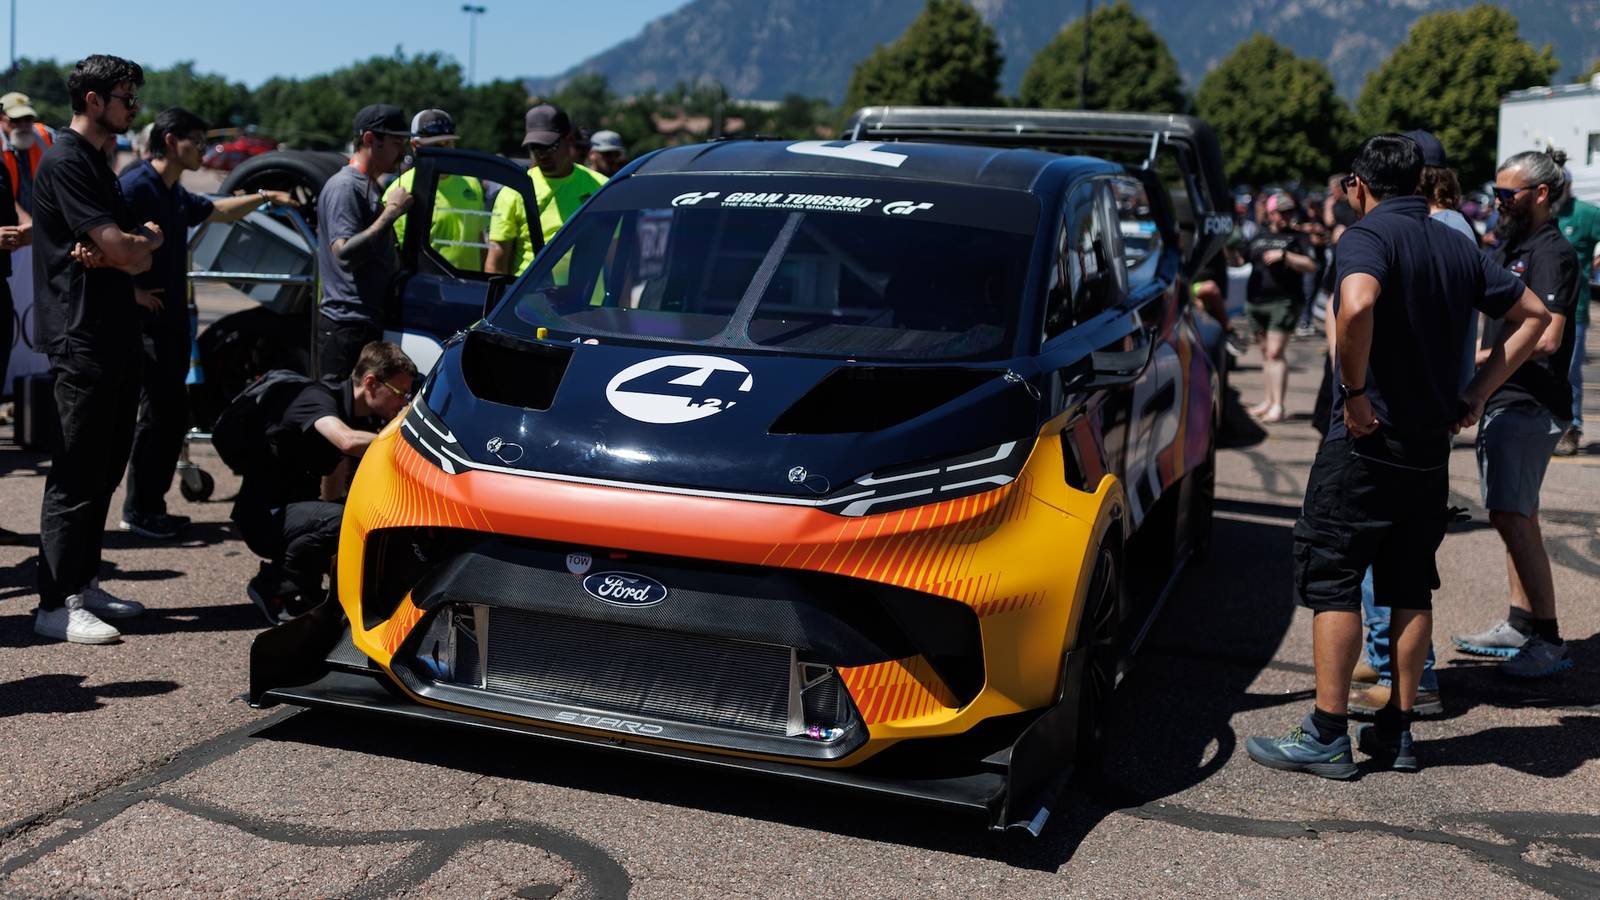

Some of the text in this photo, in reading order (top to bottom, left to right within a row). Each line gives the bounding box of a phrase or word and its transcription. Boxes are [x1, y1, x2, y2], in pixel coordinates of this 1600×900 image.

[724, 191, 784, 203] GRAN
[765, 202, 804, 210] DRIVING
[805, 204, 862, 213] SIMULATOR
[1204, 215, 1233, 234] FORD
[567, 554, 590, 566] TOW
[598, 574, 651, 601] Ford
[555, 711, 664, 734] STARD
